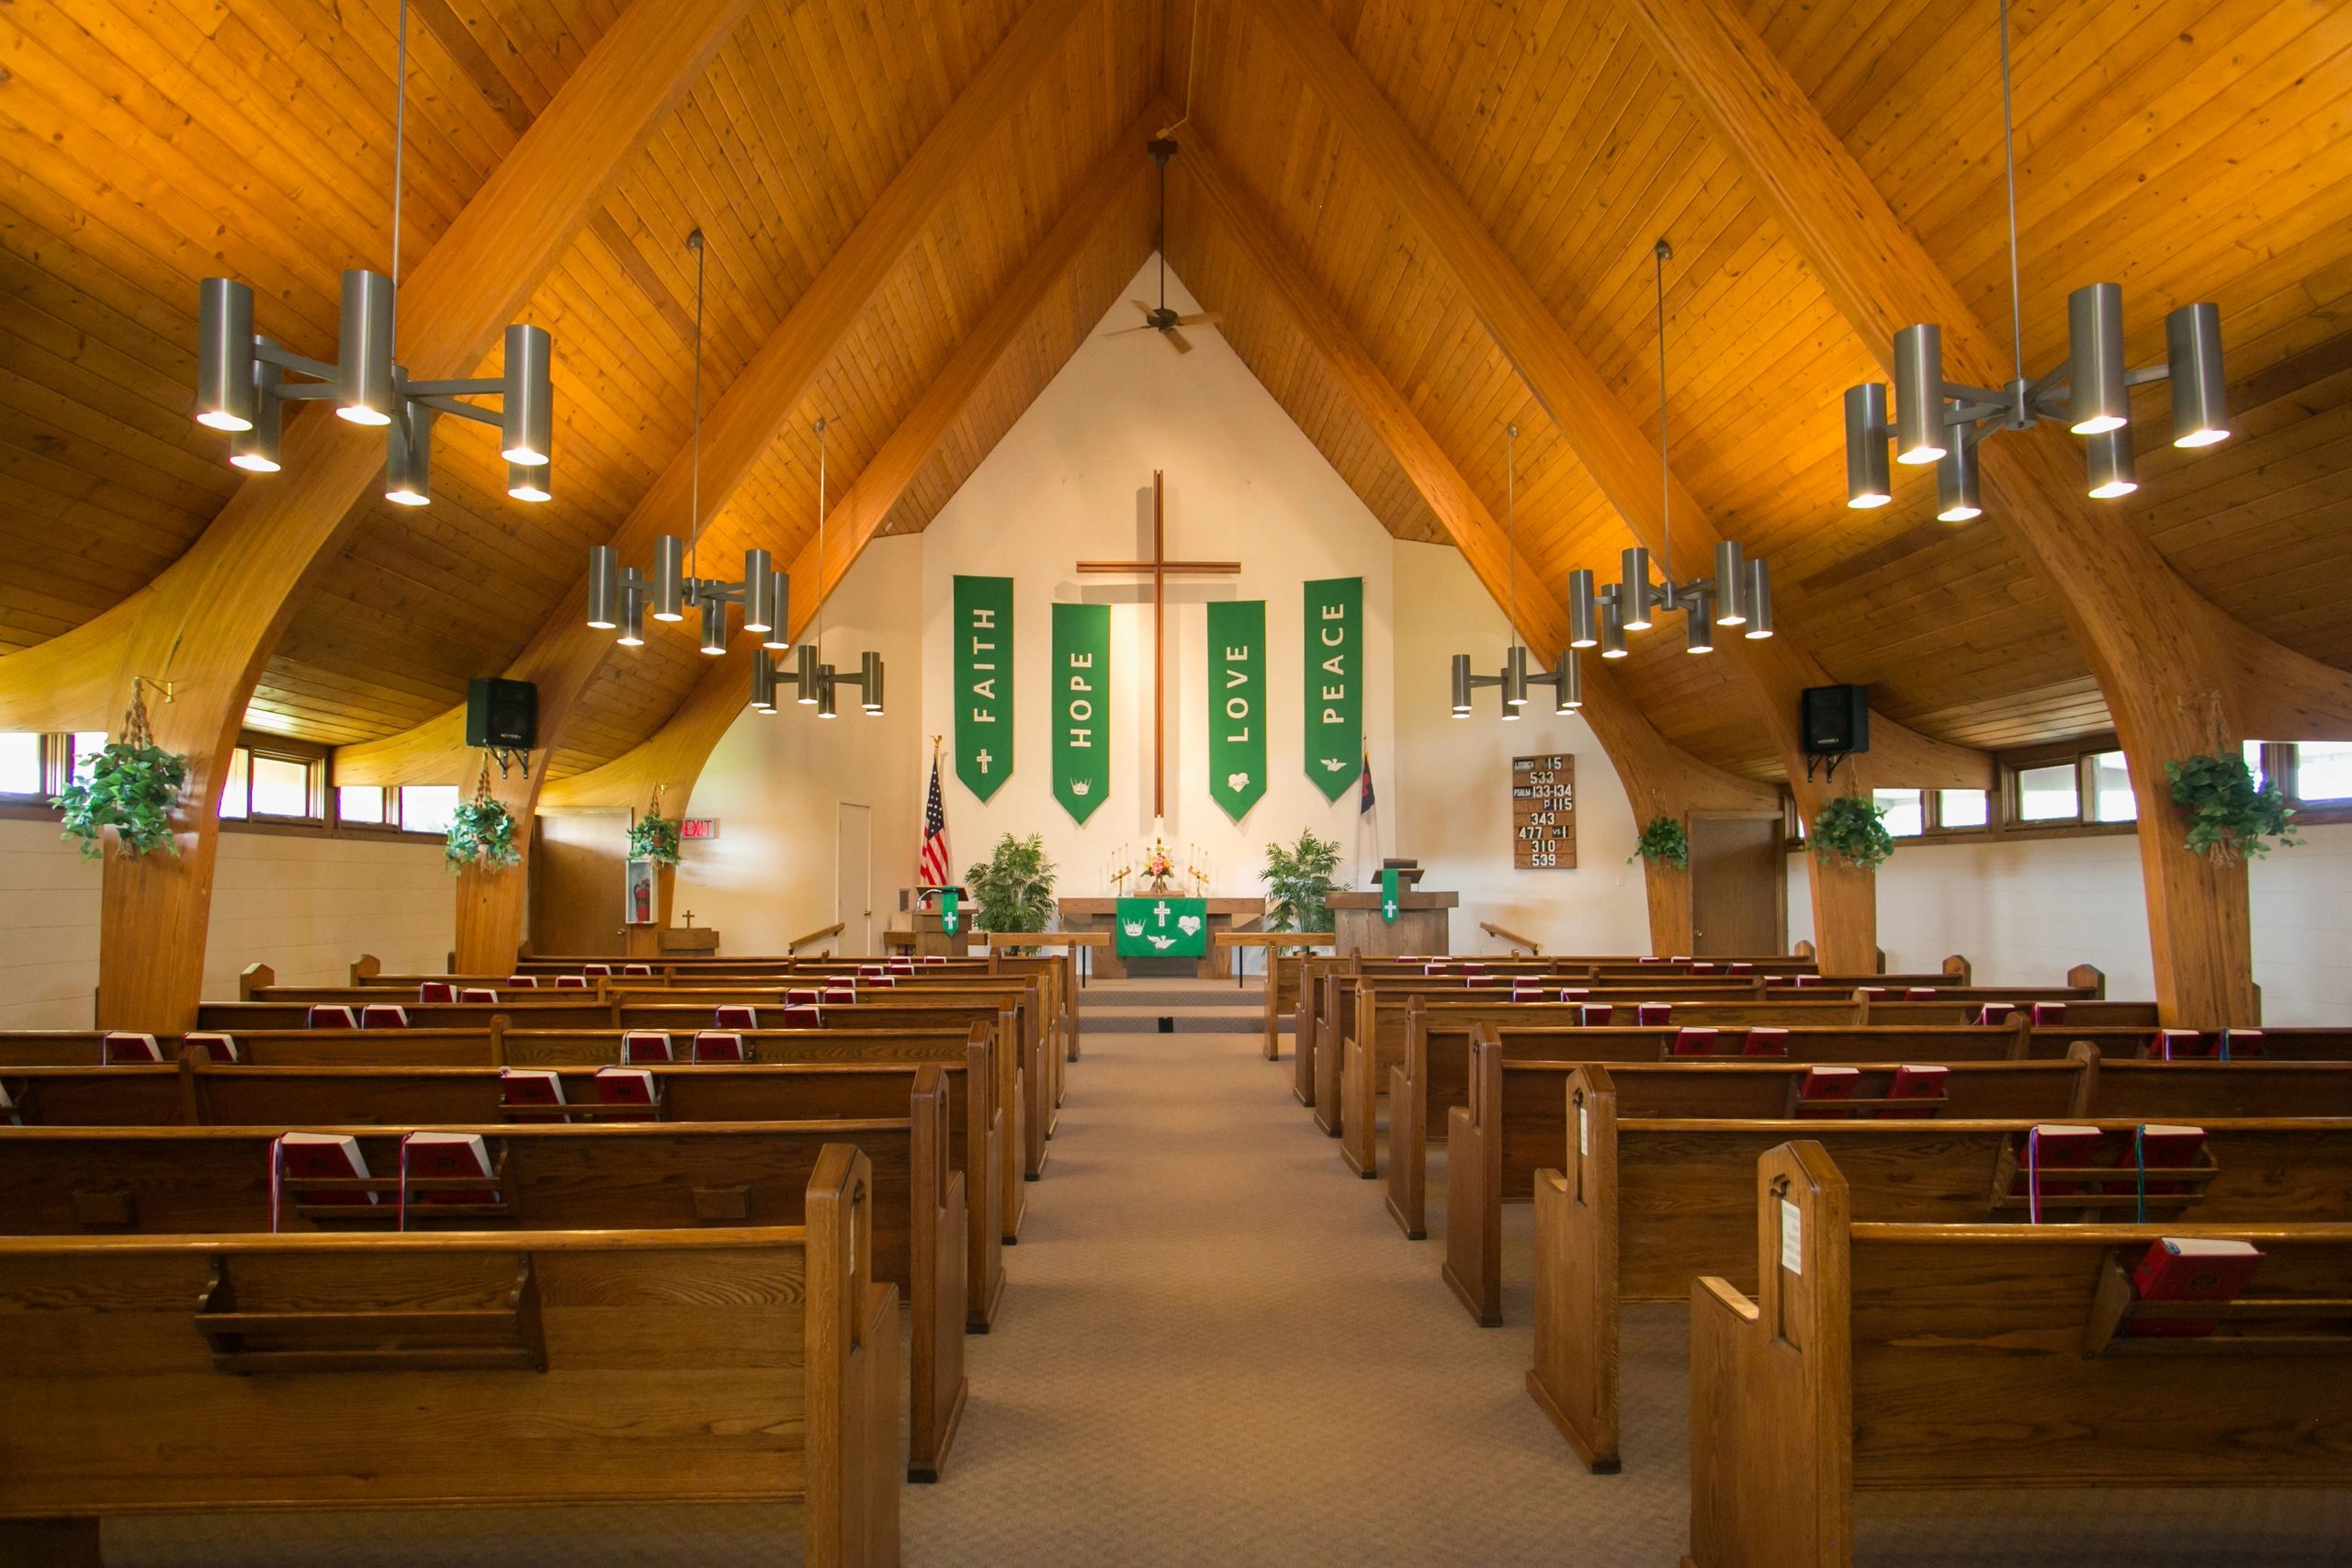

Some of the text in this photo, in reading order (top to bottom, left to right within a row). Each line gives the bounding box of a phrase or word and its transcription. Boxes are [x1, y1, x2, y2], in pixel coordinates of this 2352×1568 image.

[973, 609, 996, 723] FAITH
[1321, 604, 1344, 724] PEACE
[1069, 652, 1092, 748] HOPE
[1227, 645, 1250, 742] LOVE
[1548, 757, 1561, 770] 15
[1530, 772, 1555, 784] 533
[1514, 784, 1572, 798] PSALM 133-134
[1554, 797, 1572, 810] 115
[1531, 813, 1555, 825] 343
[683, 819, 712, 838] EXIT
[1519, 827, 1543, 839] 477
[1532, 840, 1555, 852] 310
[1532, 854, 1556, 866] 539
